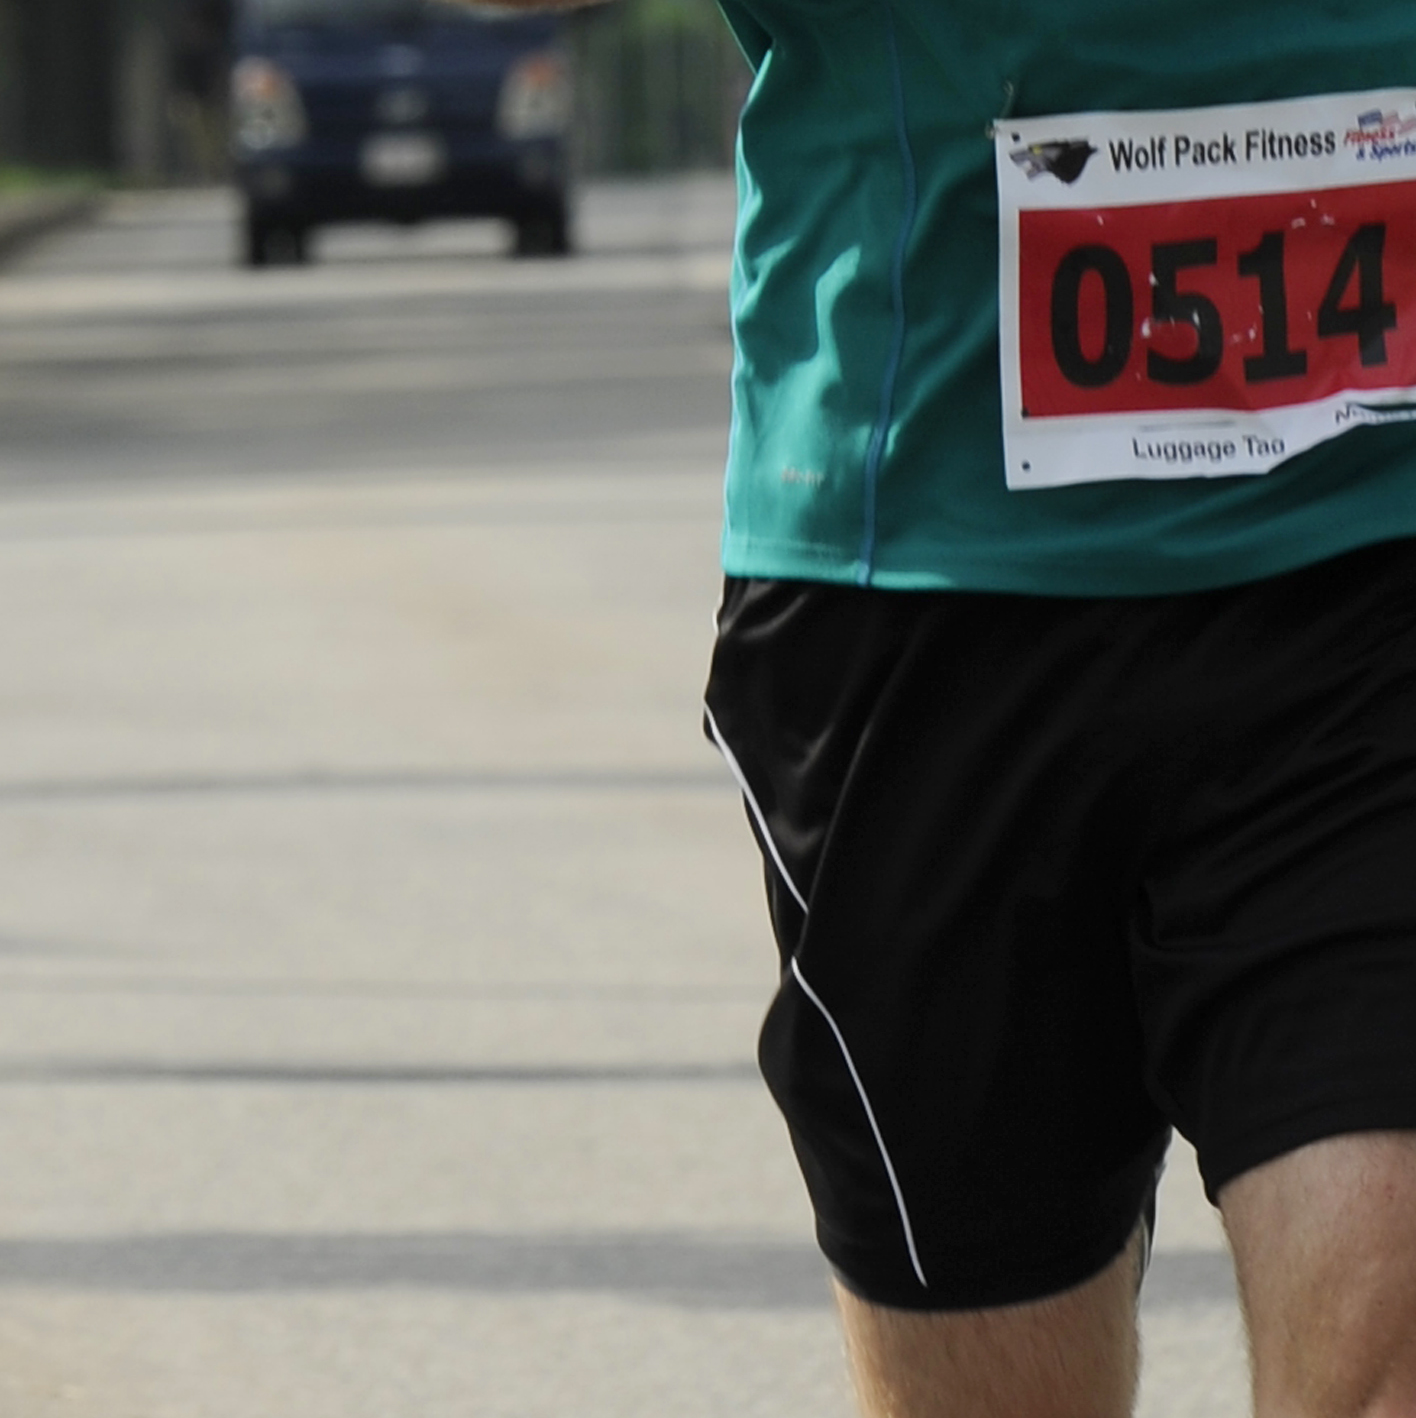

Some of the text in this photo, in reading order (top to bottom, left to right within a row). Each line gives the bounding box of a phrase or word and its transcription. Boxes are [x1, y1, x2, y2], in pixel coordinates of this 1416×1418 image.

[1109, 128, 1336, 172] Wolf Pack Fitness
[1051, 221, 1397, 390] 0514
[1132, 437, 1236, 464] Luggage
